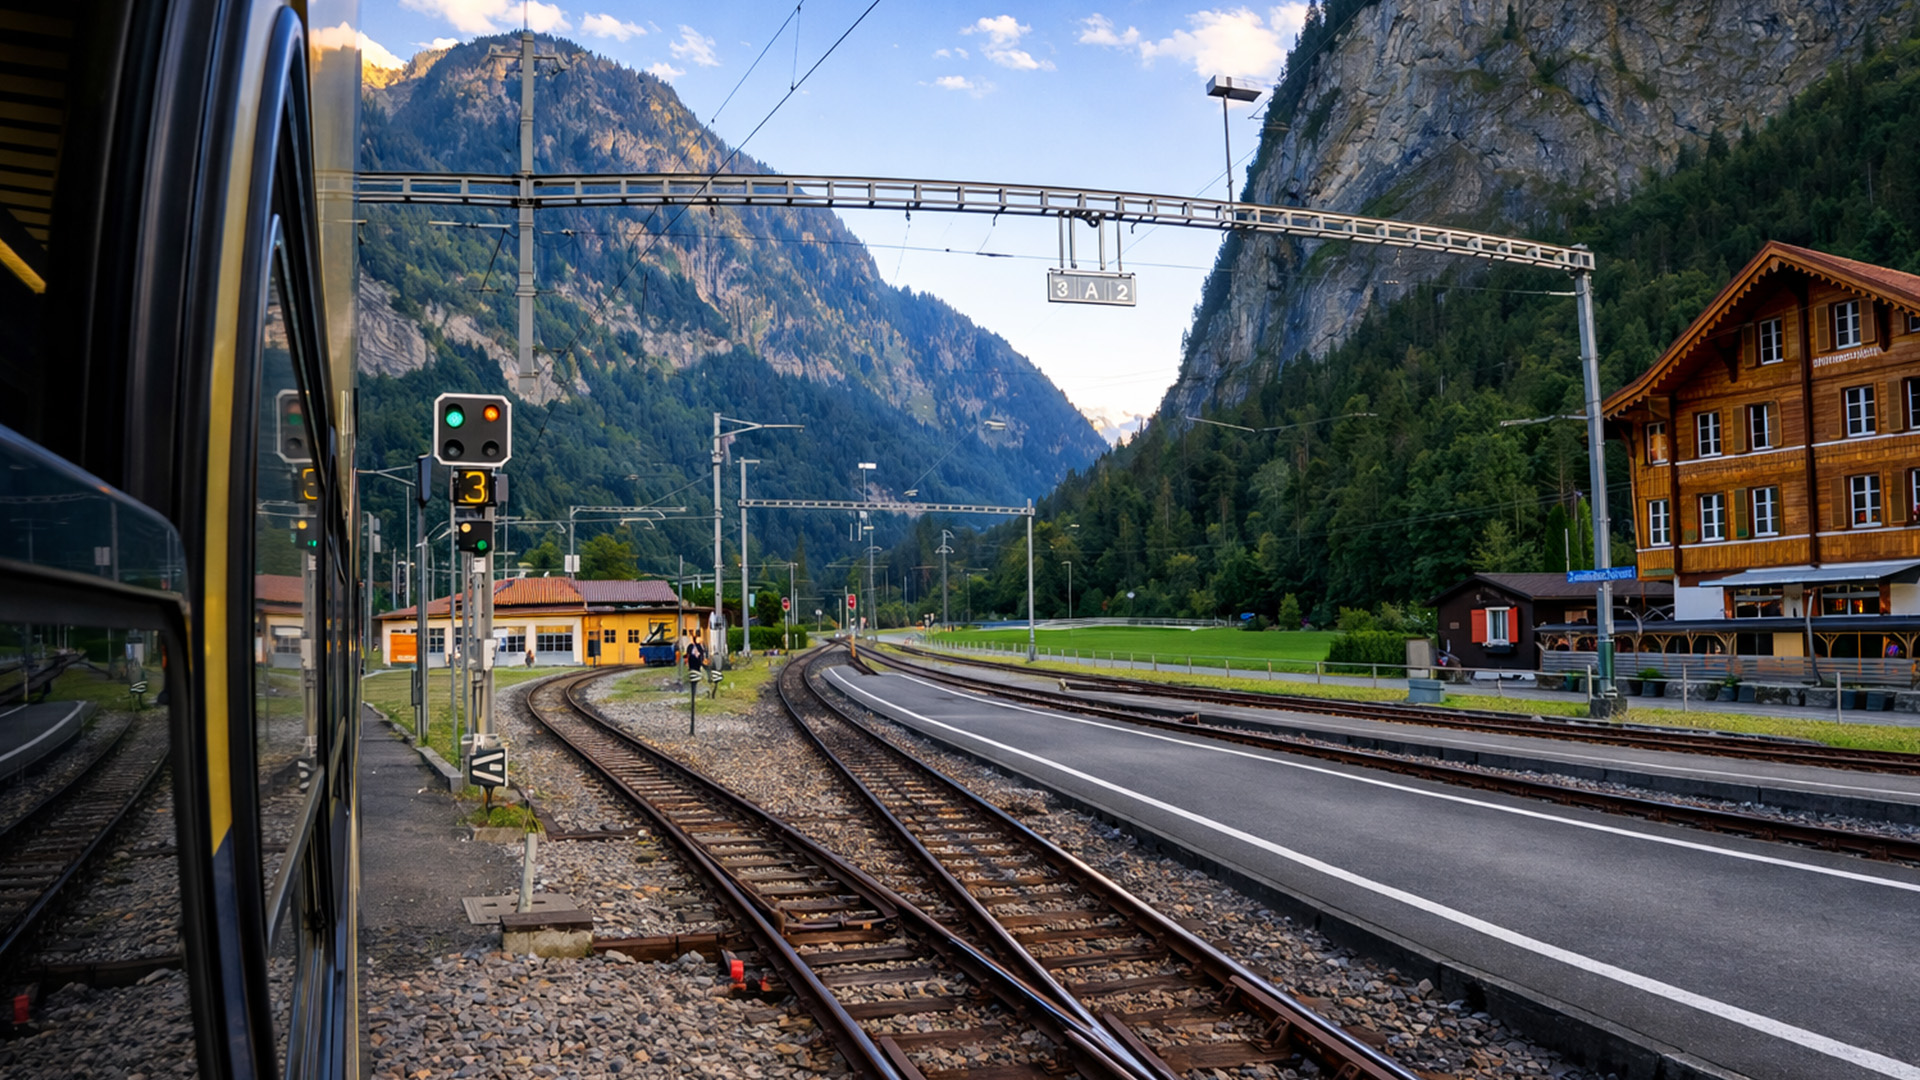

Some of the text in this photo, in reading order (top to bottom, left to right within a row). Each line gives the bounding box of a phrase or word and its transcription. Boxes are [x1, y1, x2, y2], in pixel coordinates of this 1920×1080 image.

[1056, 281, 1129, 300] 3 A 2
[464, 470, 487, 504] 3
